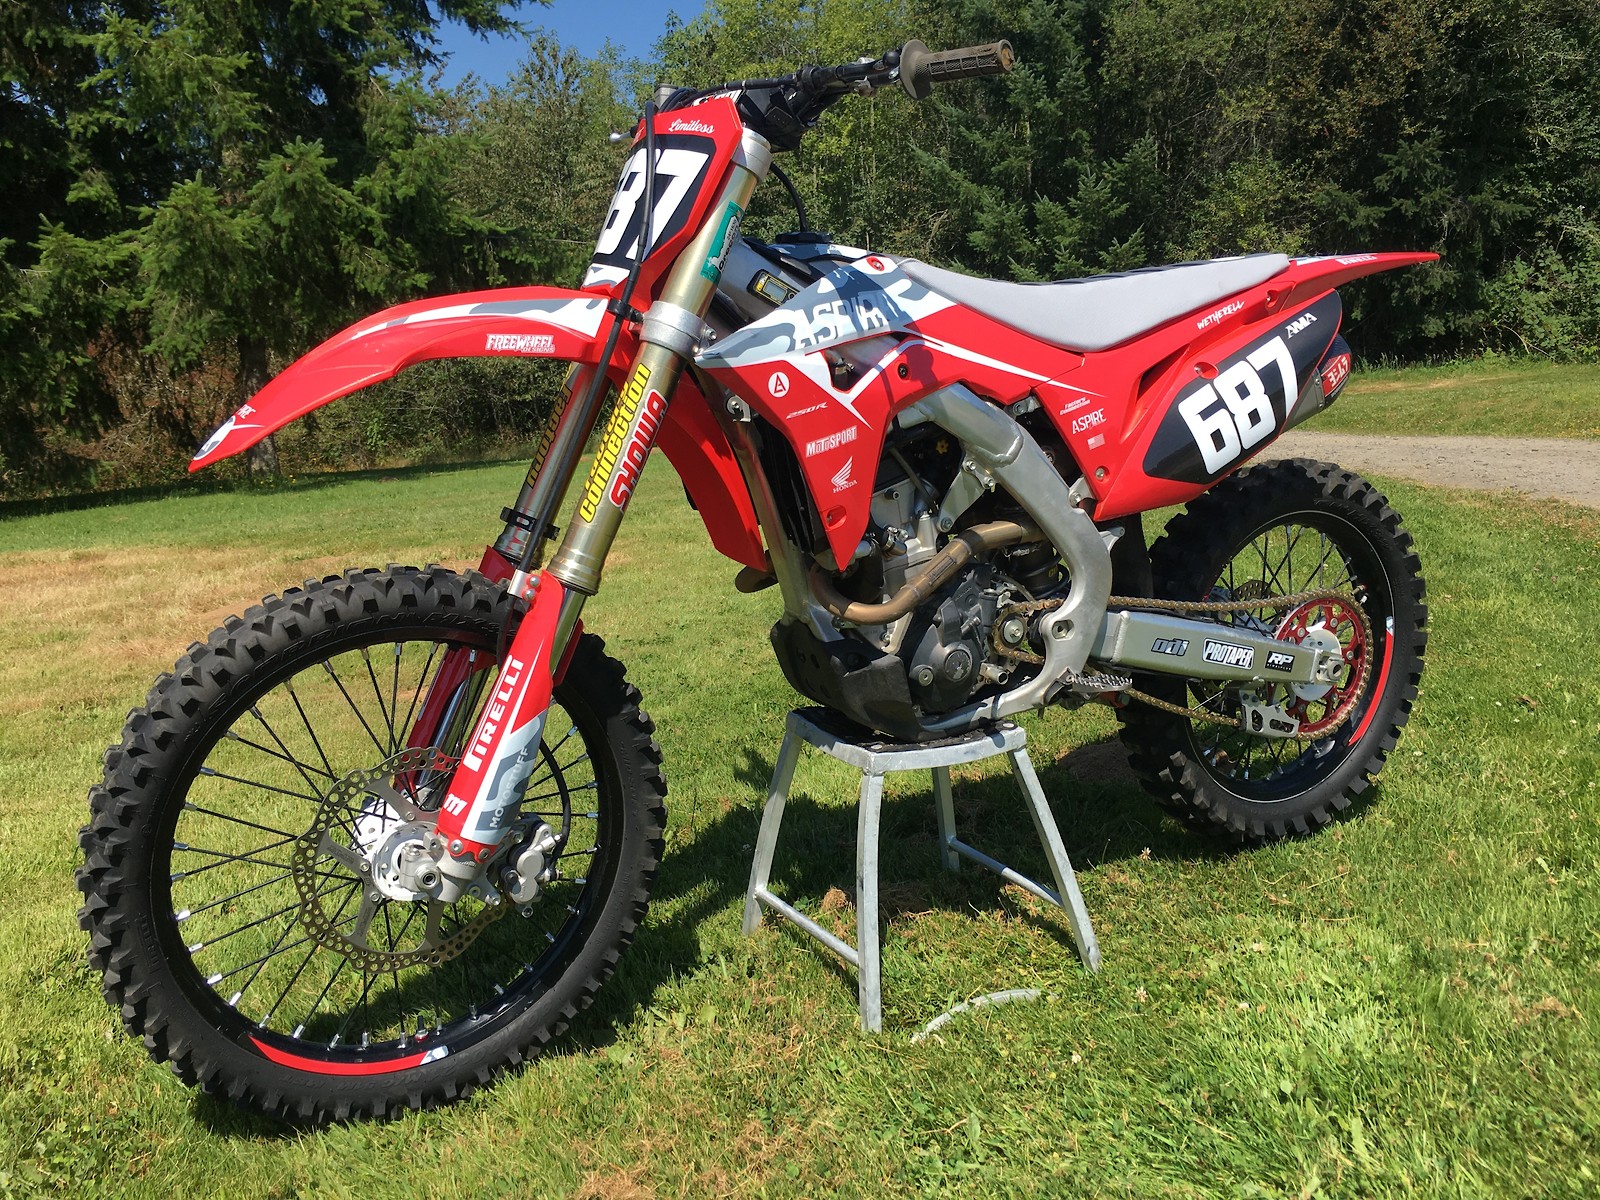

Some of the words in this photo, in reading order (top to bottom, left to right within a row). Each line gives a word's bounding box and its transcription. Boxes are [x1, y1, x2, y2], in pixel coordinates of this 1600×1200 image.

[668, 118, 715, 134] Limitless
[594, 148, 710, 262] 87
[1197, 300, 1245, 330] WETHERELL
[1285, 312, 1318, 339] AMA
[486, 334, 554, 351] FREEWHEEL
[1178, 336, 1298, 475] 687
[1072, 408, 1107, 435] ASPIRE
[609, 389, 669, 514] SHOWA
[833, 479, 858, 494] HONDA
[1205, 642, 1253, 668] PROTAPER
[1267, 652, 1294, 665] RP
[463, 654, 525, 772] PIRELLI
[489, 746, 529, 828] MOTOSTUFF
